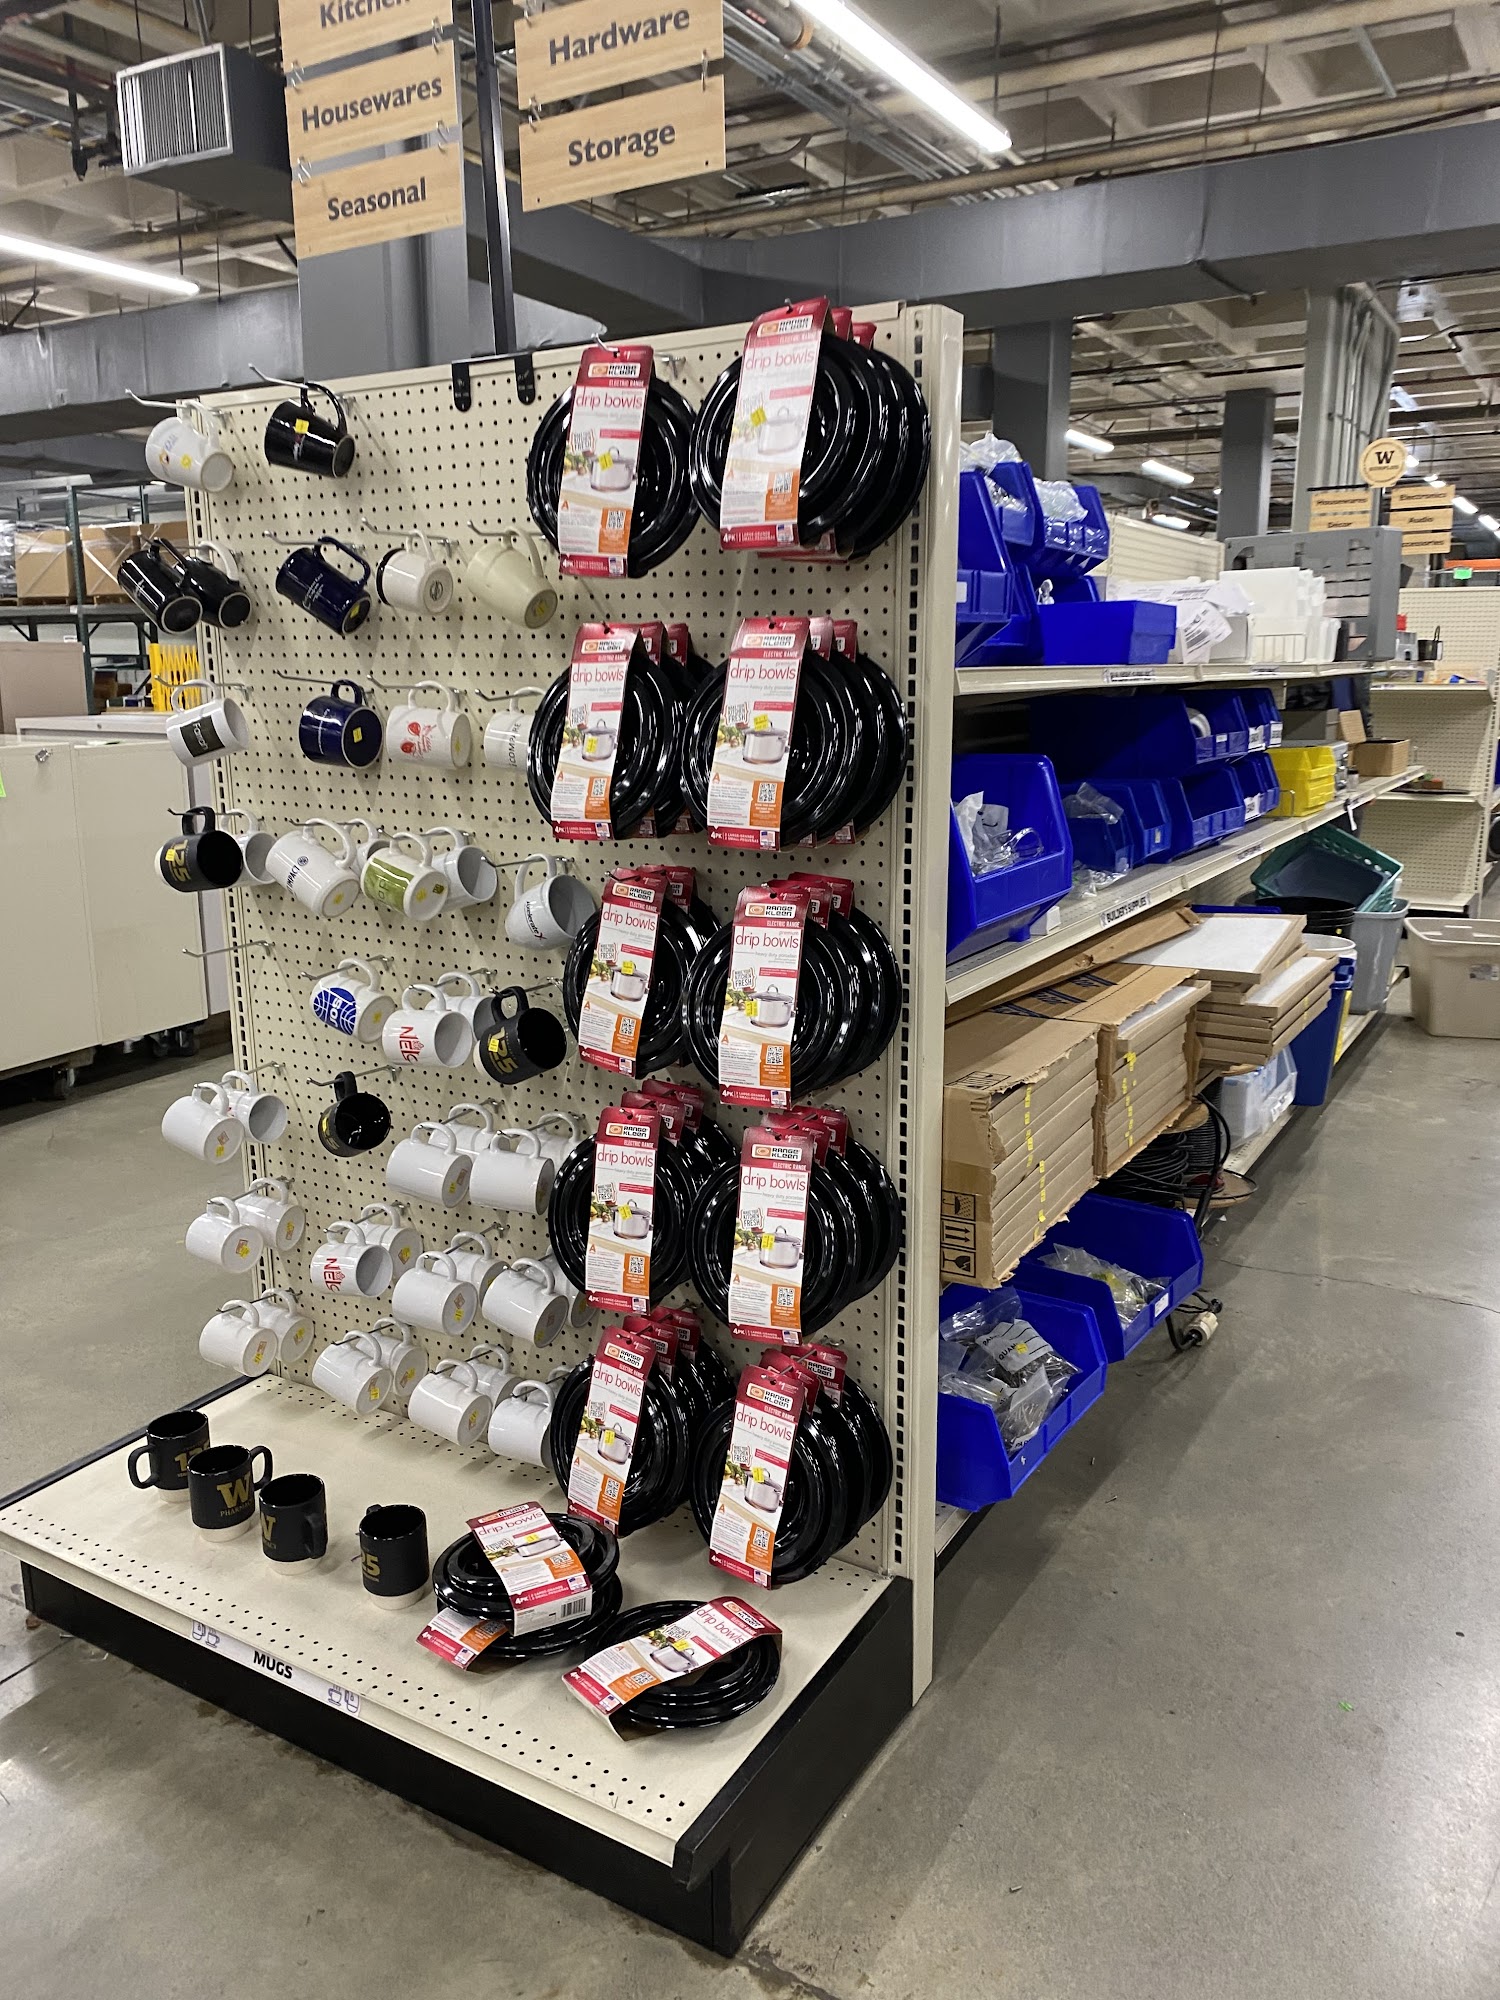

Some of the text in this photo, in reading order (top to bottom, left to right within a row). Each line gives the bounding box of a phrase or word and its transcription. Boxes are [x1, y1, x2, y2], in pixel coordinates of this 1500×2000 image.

[320, 0, 409, 28] Kitche
[549, 9, 690, 65] Hardware
[301, 76, 443, 132] Housewares
[567, 124, 676, 167] Storage
[327, 178, 427, 221] Seasonal
[744, 350, 815, 372] drip bowls
[576, 386, 642, 410] drip bowls
[1375, 450, 1395, 464] W
[572, 663, 624, 685] drip bowls
[730, 658, 796, 682] drip bowls
[629, 892, 651, 900] KLEEN
[630, 901, 645, 910] ELECTRIC
[1129, 896, 1146, 912] SUPPLIES
[603, 903, 656, 931] drip bowls
[735, 926, 799, 949] drip bowls
[597, 1144, 653, 1168] drip bowls
[743, 1166, 806, 1191] drip bowls
[808, 1361, 832, 1371] RANGE
[593, 1362, 641, 1397] drip bowls
[764, 1395, 789, 1408] KLEEN
[765, 1390, 790, 1403] RANGE
[736, 1405, 792, 1441] drip bowls
[216, 1470, 252, 1508] W
[220, 1500, 252, 1517] PHARMAC
[478, 1525, 504, 1536] drip
[505, 1511, 543, 1529] bowls
[515, 1596, 528, 1604] 4PK
[696, 1607, 744, 1645] drip bowls
[253, 1650, 293, 1680] MUGS
